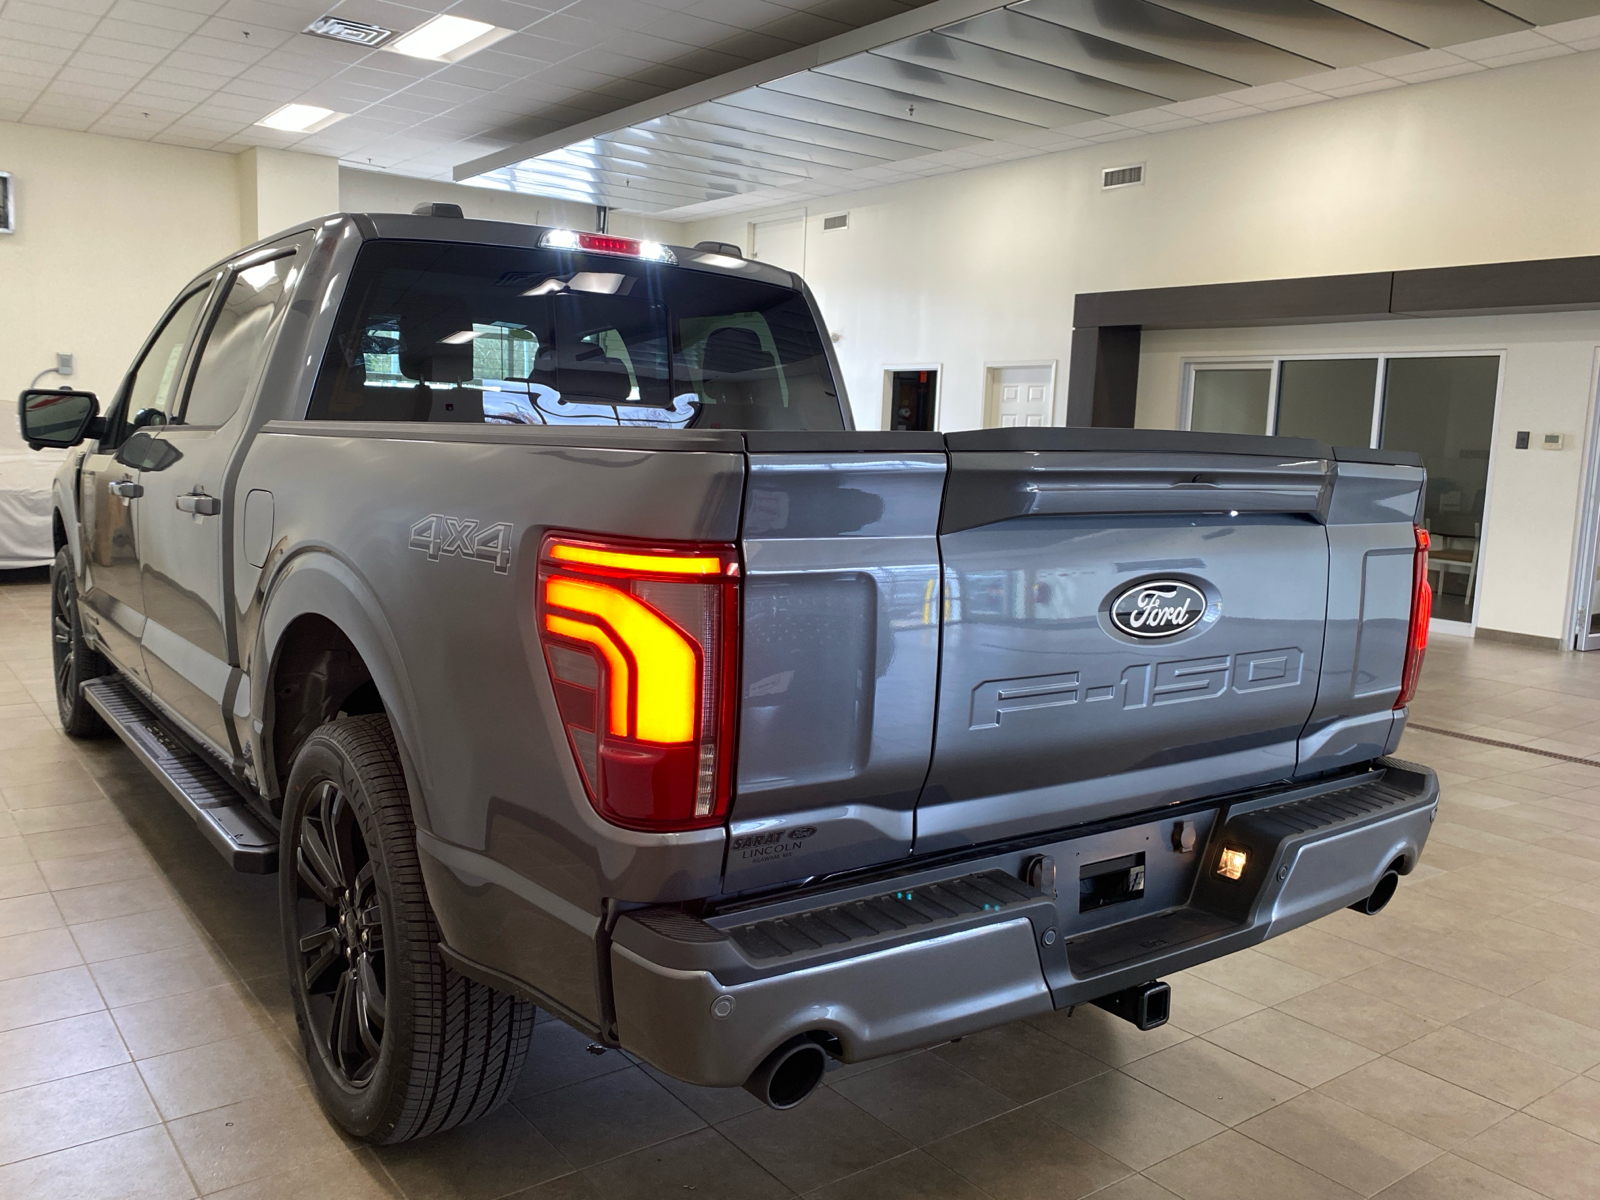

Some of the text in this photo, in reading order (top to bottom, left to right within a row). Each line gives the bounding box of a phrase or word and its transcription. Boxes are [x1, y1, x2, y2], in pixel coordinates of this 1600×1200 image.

[408, 513, 514, 576] 4X4
[1130, 589, 1191, 628] Ford
[968, 646, 1304, 731] F-150
[346, 778, 382, 874] ALENZA
[731, 829, 786, 851] SARAT
[742, 841, 802, 859] LINCOLN
